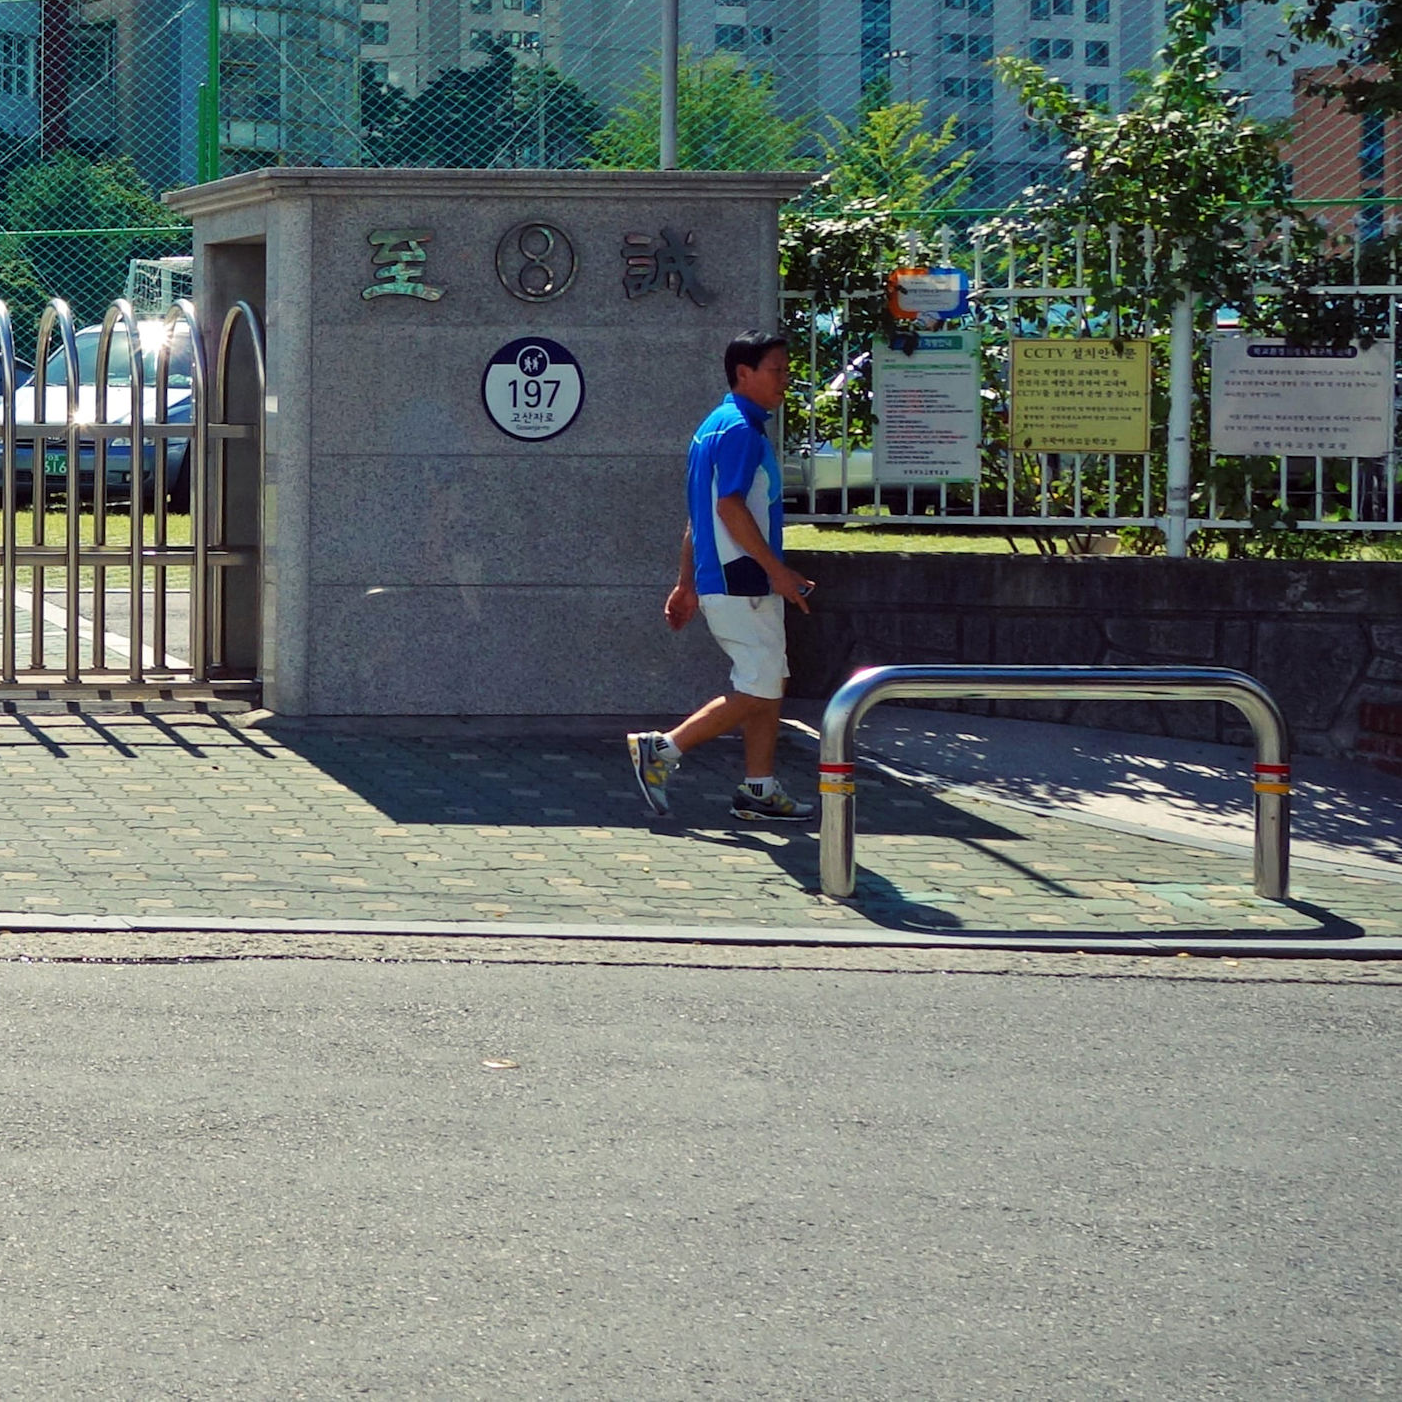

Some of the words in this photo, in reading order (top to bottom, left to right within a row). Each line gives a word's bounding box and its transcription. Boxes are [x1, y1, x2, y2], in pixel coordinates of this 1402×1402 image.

[361, 228, 446, 302] 至
[621, 225, 717, 308] 誠
[1023, 348, 1067, 358] CCTV
[508, 379, 561, 408] 197
[510, 412, 555, 424] 고산자로
